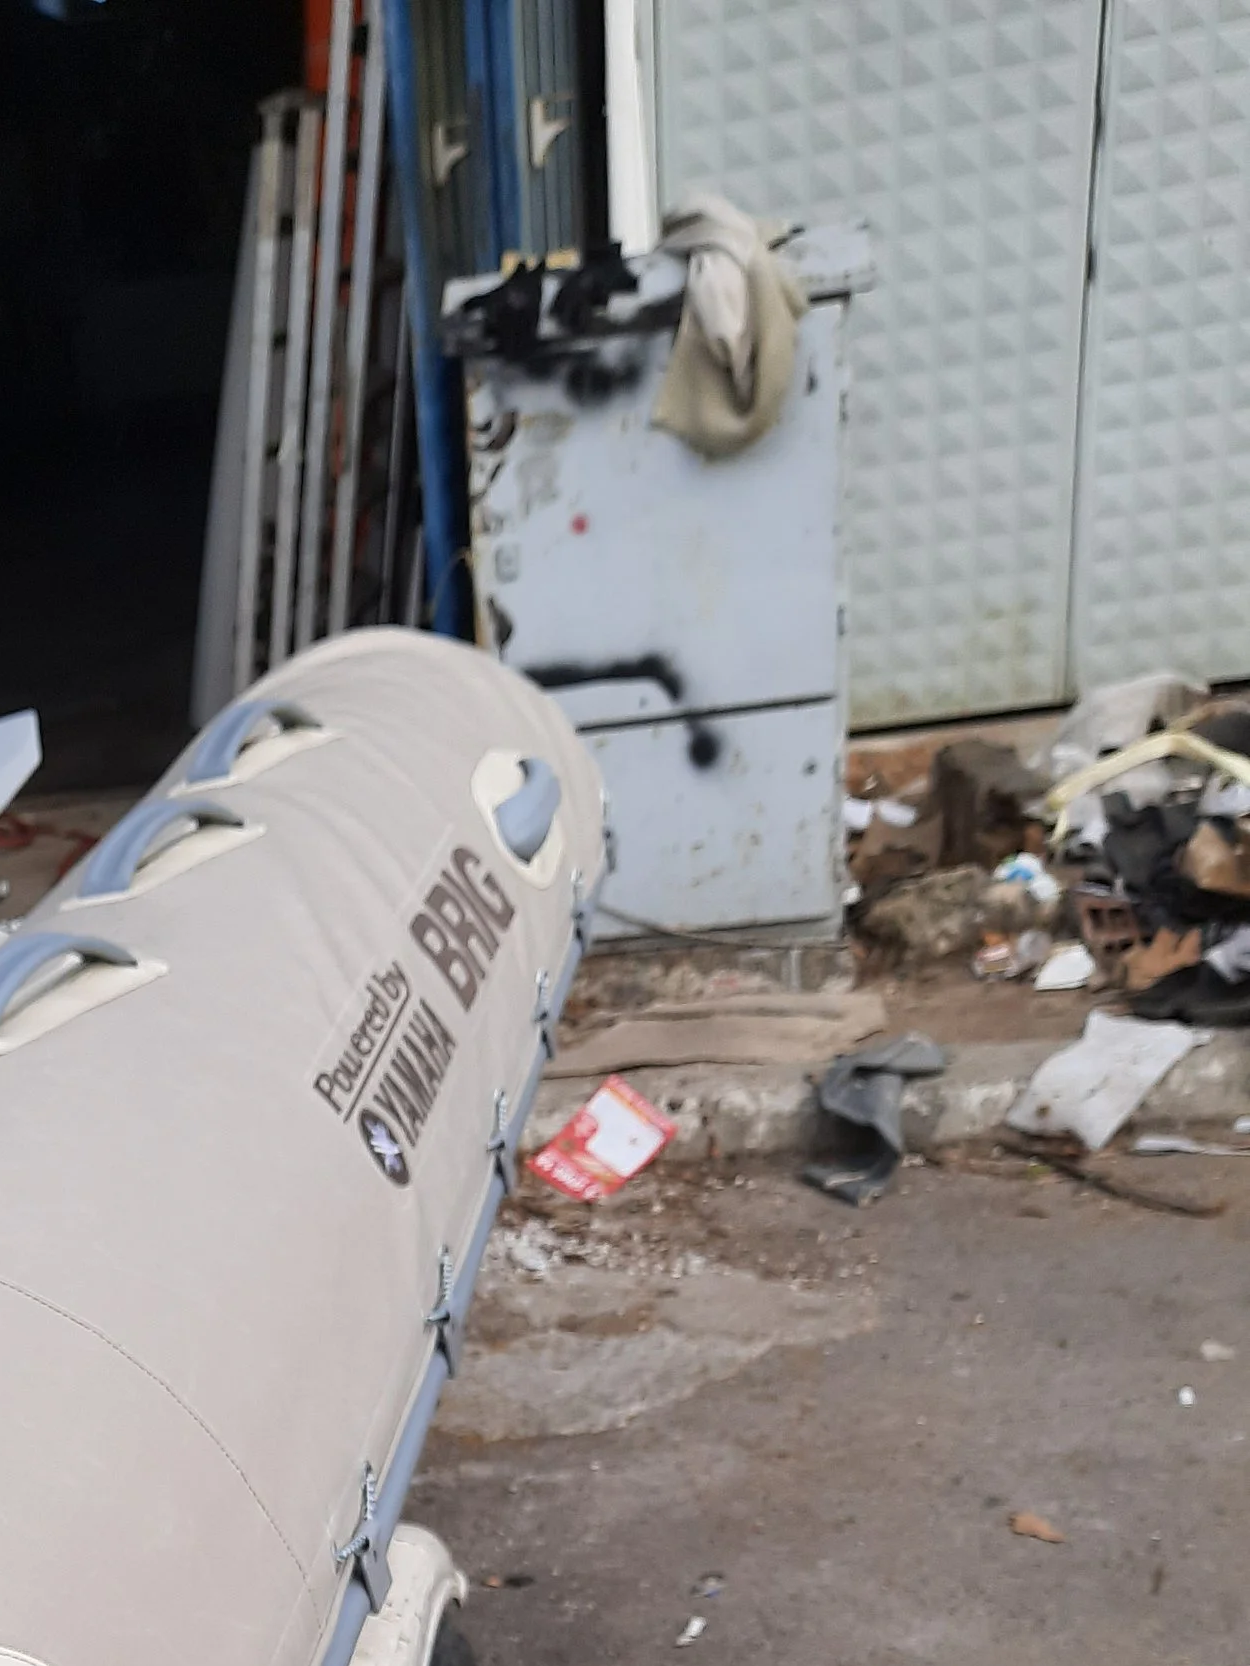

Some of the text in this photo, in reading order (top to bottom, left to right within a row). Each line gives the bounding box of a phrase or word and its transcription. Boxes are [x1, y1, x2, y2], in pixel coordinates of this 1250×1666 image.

[409, 845, 516, 1013] BRIG
[312, 959, 411, 1116] Powered by
[372, 997, 457, 1148] YAMAHA
